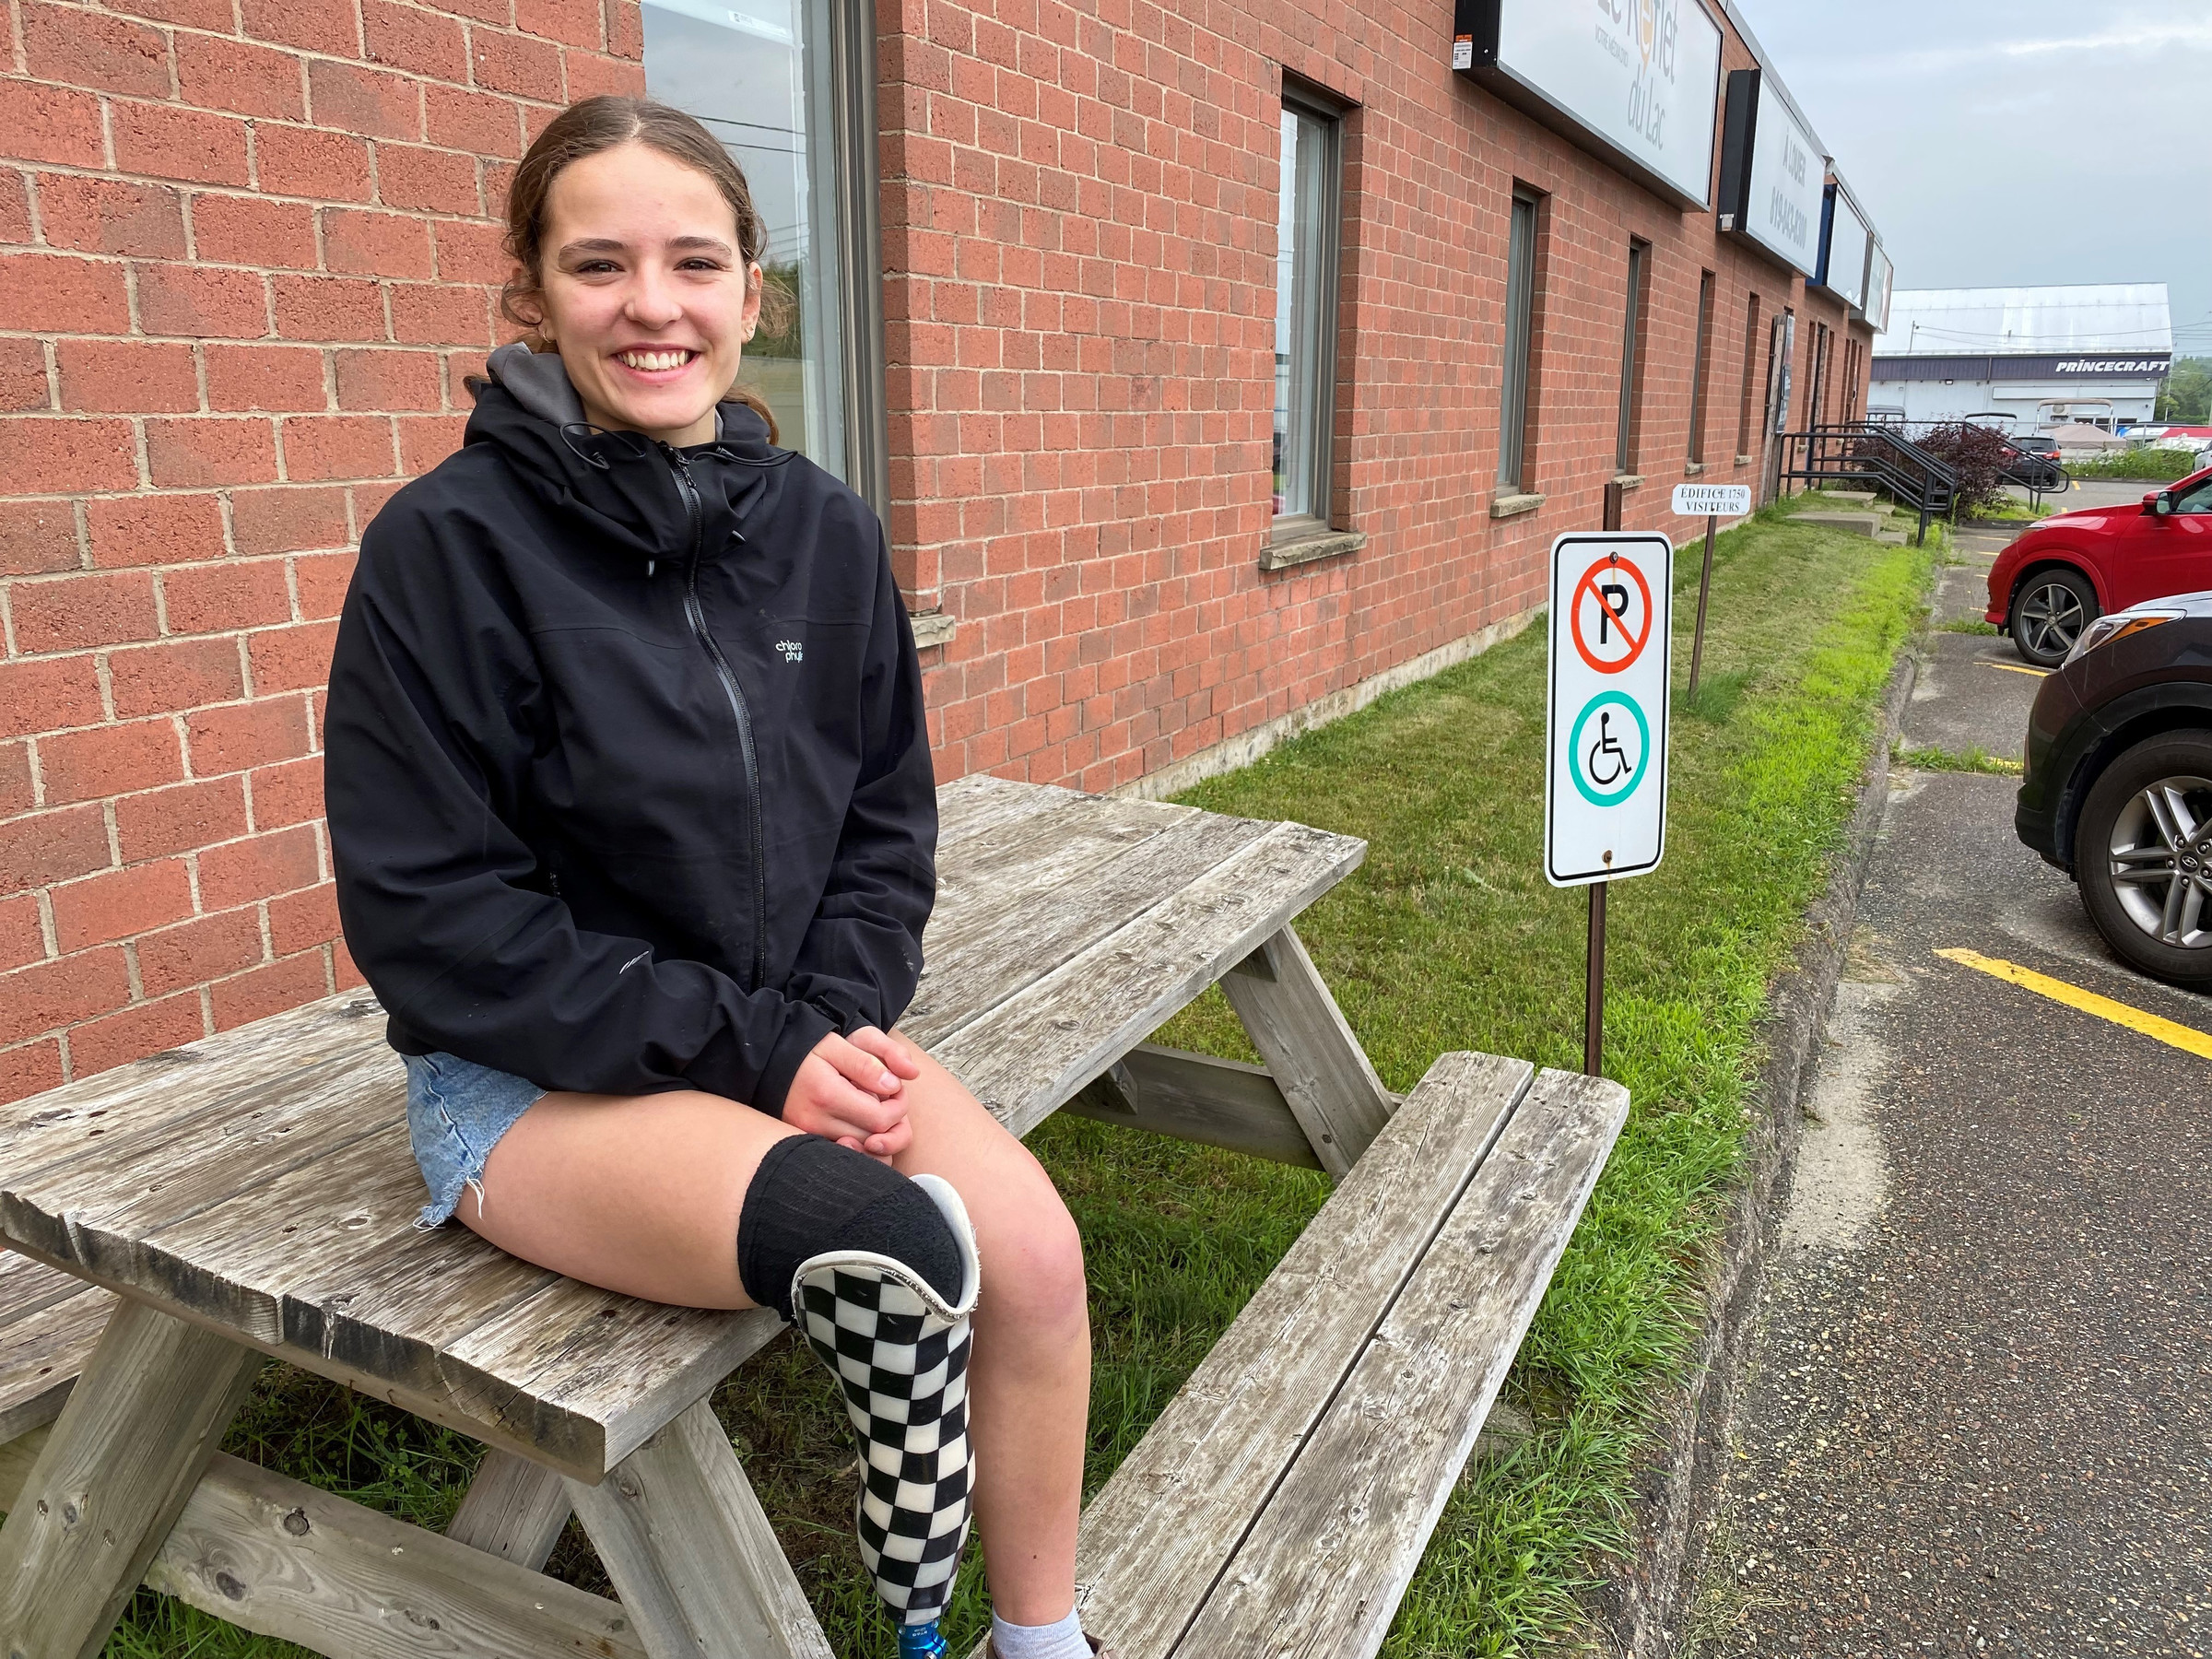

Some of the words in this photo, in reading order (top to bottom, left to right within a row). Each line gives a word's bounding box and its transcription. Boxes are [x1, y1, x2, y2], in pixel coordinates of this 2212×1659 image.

[1628, 63, 1646, 135] du
[1645, 76, 1665, 151] Lac
[1788, 140, 1806, 188] LOUER
[1680, 485, 1726, 499] ÉDIFICE
[1729, 488, 1746, 500] 1750
[1686, 501, 1740, 512] VISITEURS
[1600, 583, 1630, 644] P
[775, 640, 803, 651] chloro
